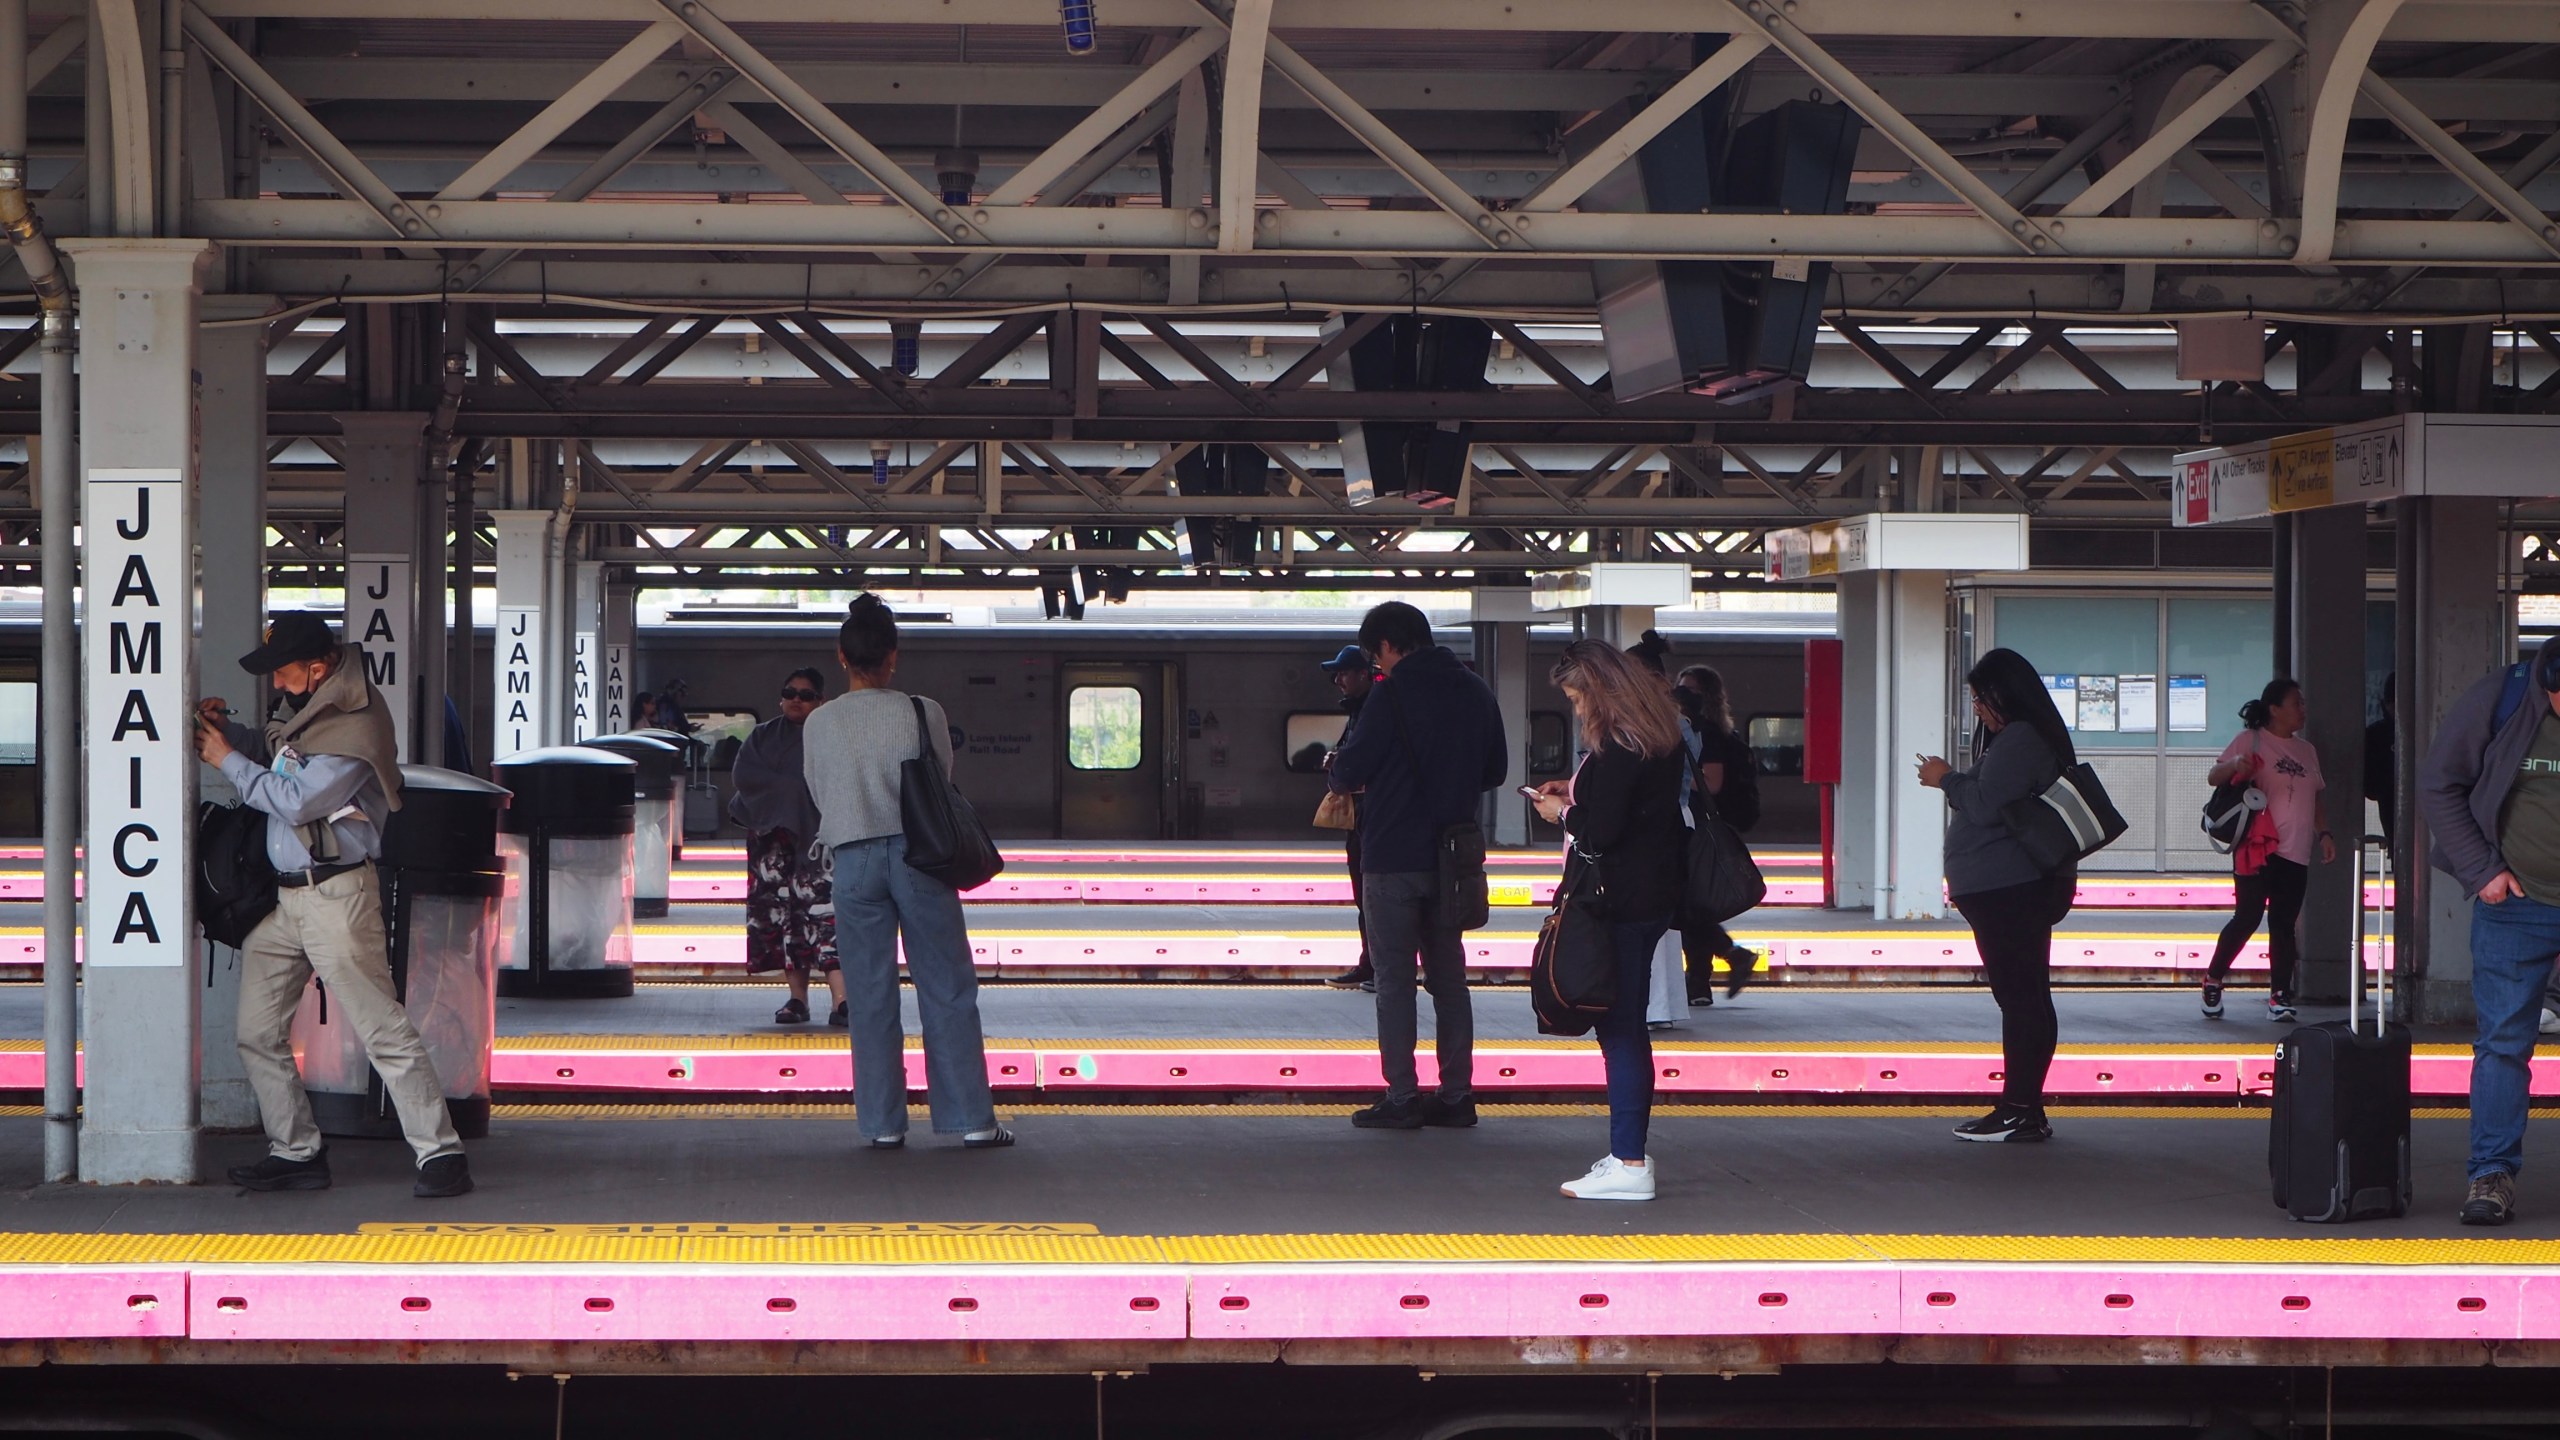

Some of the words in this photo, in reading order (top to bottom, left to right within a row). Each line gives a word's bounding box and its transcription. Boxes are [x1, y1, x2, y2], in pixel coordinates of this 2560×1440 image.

[2297, 450, 2309, 468] JFK
[2310, 447, 2330, 468] Airport
[2335, 443, 2358, 462] Elevator
[2230, 461, 2246, 478] Other
[2247, 457, 2266, 474] Tracks
[2188, 467, 2208, 502] Exit
[110, 487, 161, 944] JAMAICA
[969, 734, 995, 744] Long
[999, 734, 1032, 743] Island
[969, 745, 990, 754] Rail
[993, 745, 1021, 754] Road
[1503, 886, 1530, 897] GAP
[391, 1225, 556, 1233] GAP
[586, 1225, 746, 1233] THE
[777, 1224, 1062, 1233] WATCH
